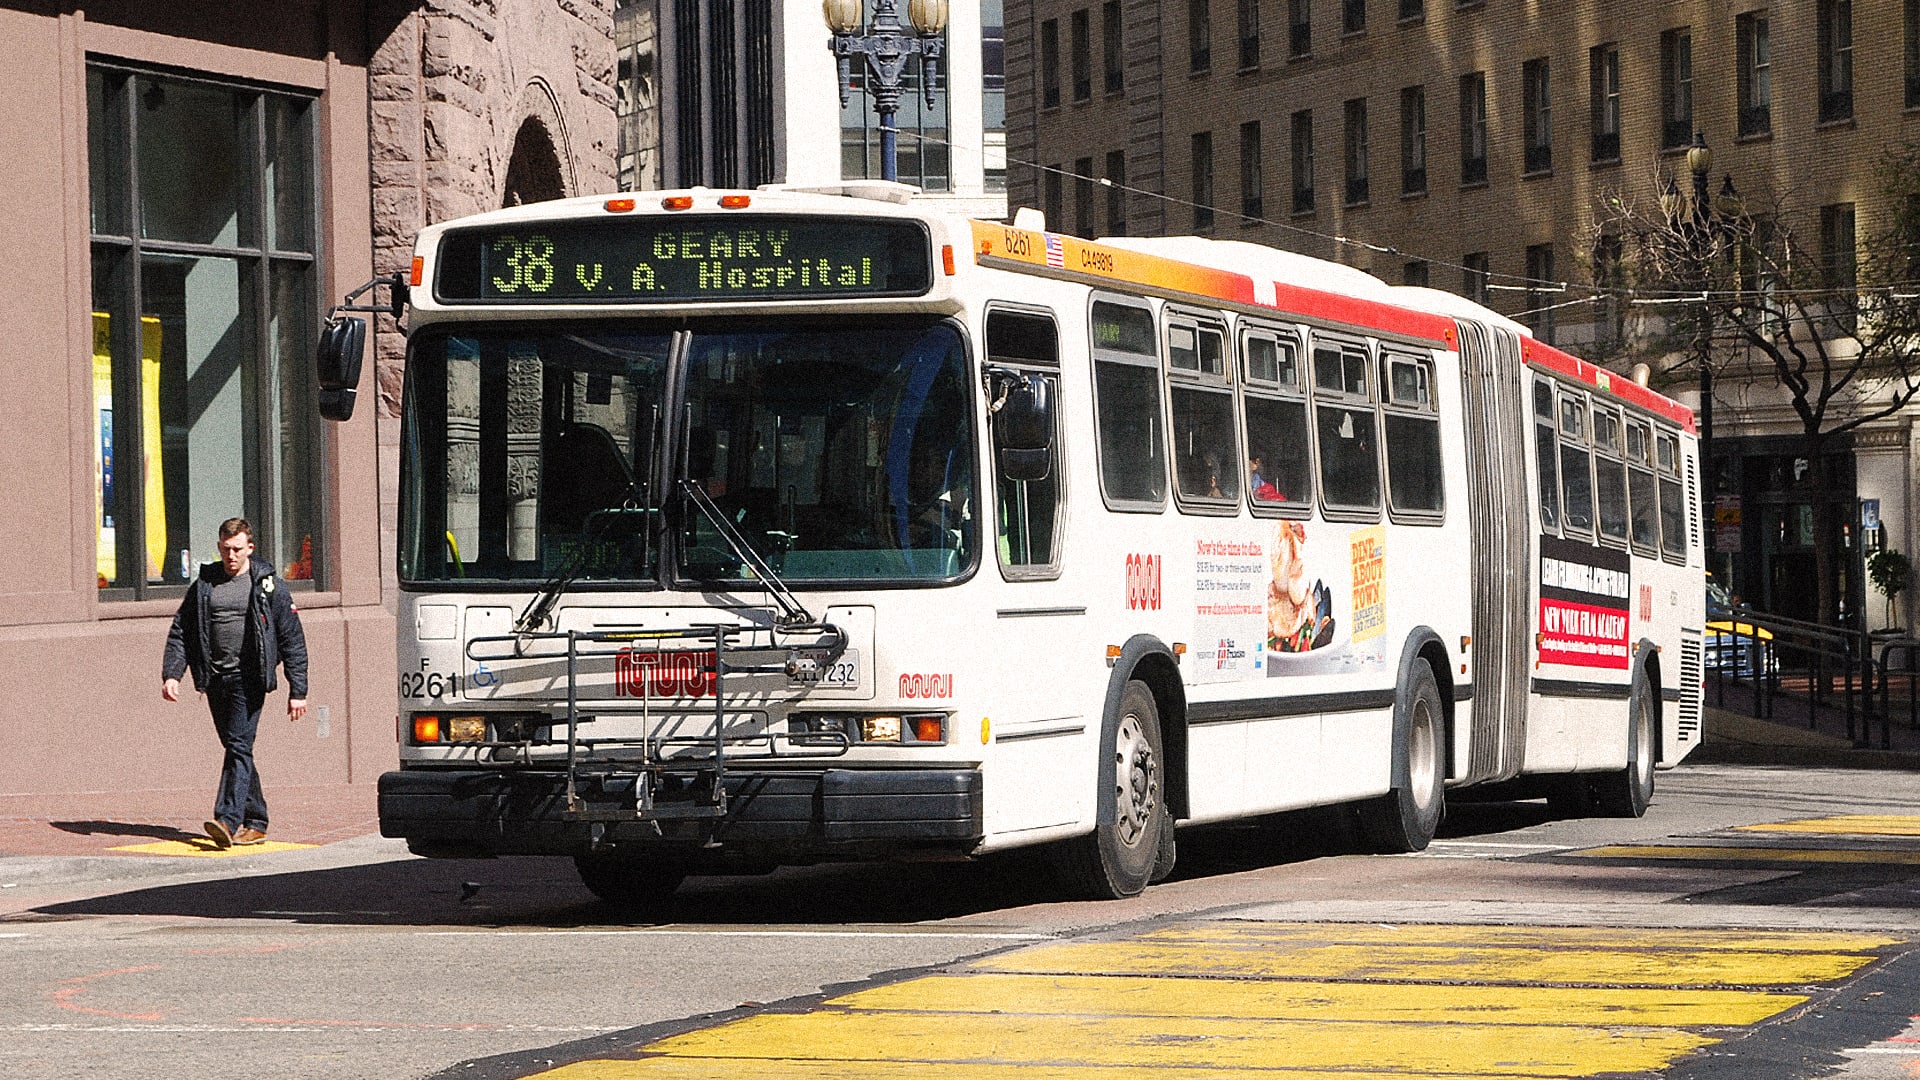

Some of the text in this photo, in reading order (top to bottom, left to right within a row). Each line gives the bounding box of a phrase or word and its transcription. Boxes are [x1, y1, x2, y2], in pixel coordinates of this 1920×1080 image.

[654, 229, 790, 259] GEARY
[1004, 229, 1031, 257] 6261
[493, 235, 553, 293] 38
[632, 262, 665, 290] A.
[699, 257, 872, 290] Hospital
[1352, 537, 1374, 565] DINE
[1353, 558, 1383, 588] ABOUT
[1353, 581, 1380, 611] TOWN
[1544, 605, 1560, 634] NEW
[1580, 611, 1597, 637] FILM
[421, 658, 430, 672] F
[402, 672, 456, 698] 6261
